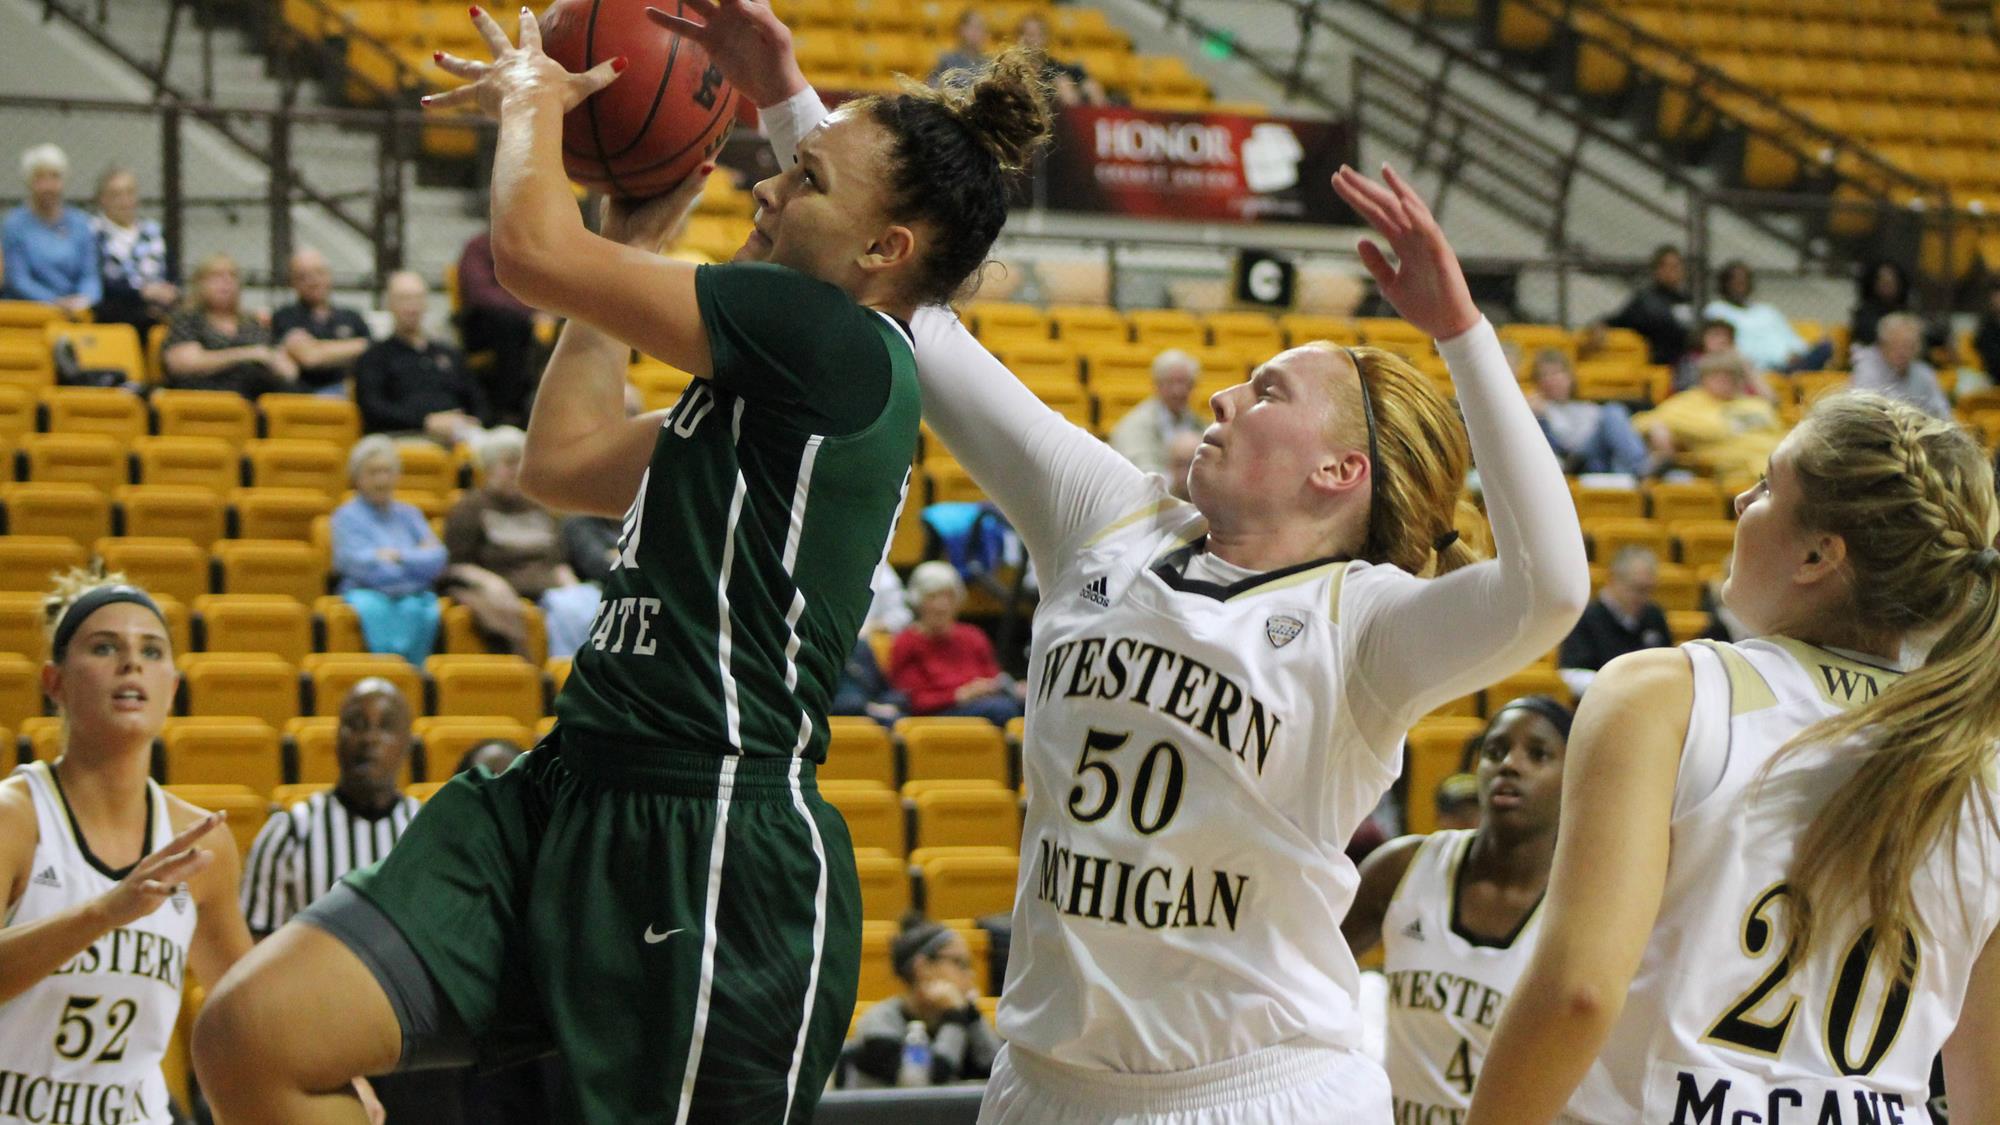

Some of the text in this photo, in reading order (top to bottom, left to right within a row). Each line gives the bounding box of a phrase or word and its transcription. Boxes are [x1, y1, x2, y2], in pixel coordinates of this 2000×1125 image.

[1094, 117, 1234, 165] HONOR
[1036, 637, 1281, 777] WESTERN
[1068, 727, 1188, 836] 50
[1039, 839, 1250, 931] MCHIGAN
[1697, 879, 1921, 1077] 20
[54, 994, 139, 1064] 52
